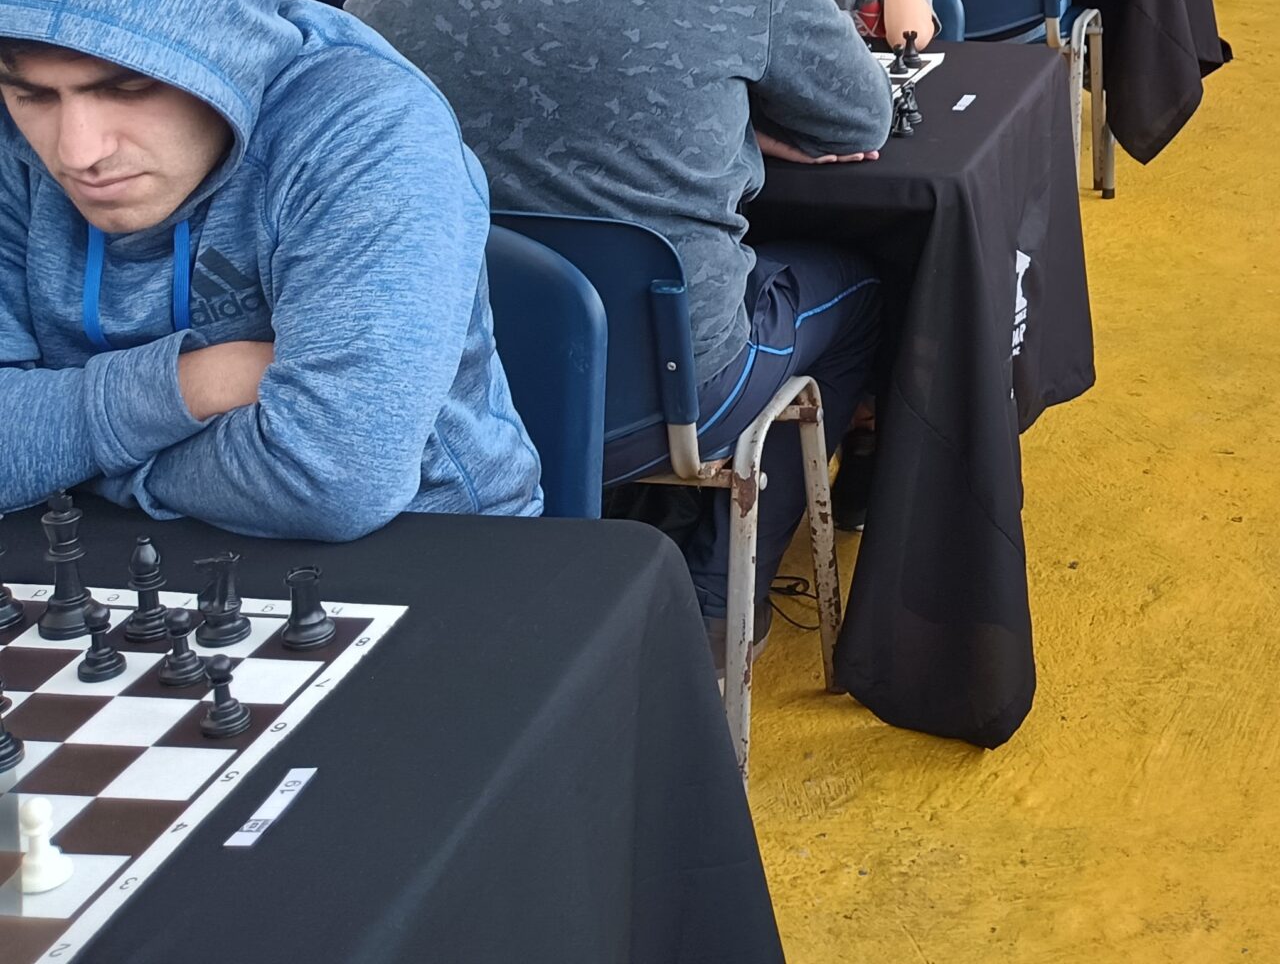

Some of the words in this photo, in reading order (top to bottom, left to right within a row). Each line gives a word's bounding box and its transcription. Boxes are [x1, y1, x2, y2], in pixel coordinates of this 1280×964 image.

[190, 290, 261, 328] dida
[355, 636, 371, 647] 8
[315, 678, 332, 688] 7
[220, 770, 240, 782] 5
[279, 780, 302, 795] 19
[171, 822, 188, 833] 4
[119, 877, 138, 890] 3
[49, 943, 71, 958] 2
